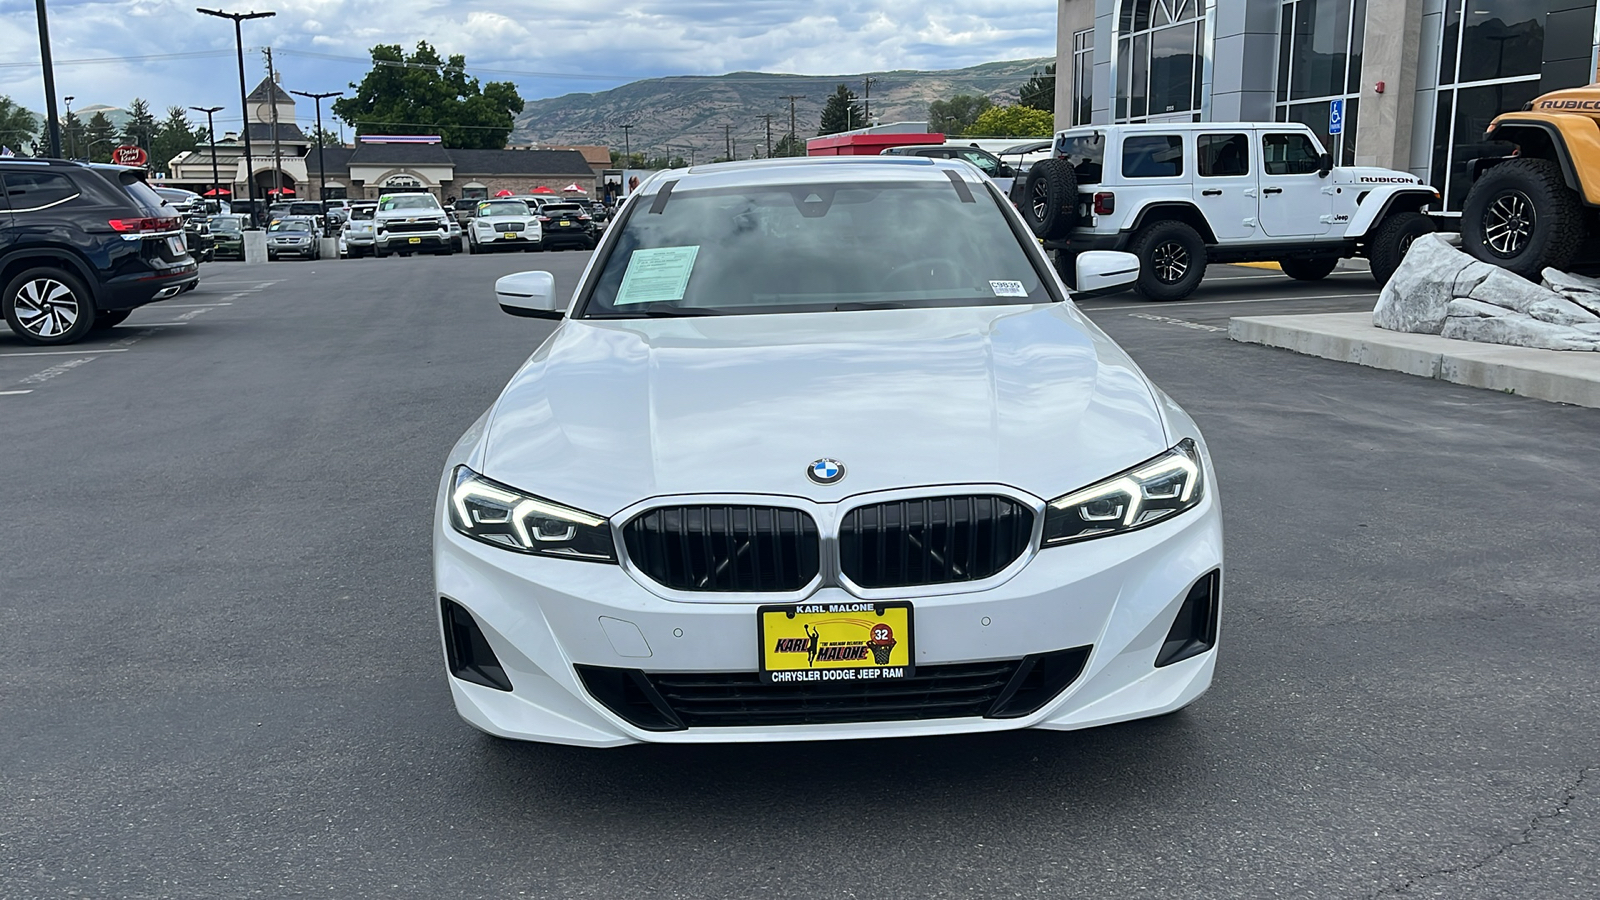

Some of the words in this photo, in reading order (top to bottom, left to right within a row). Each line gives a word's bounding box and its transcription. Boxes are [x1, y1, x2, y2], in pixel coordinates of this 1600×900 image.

[118, 148, 140, 160] Dairy
[796, 604, 826, 613] KARL
[829, 603, 874, 613] MALONE
[875, 629, 888, 640] 32
[774, 638, 810, 653] KARL
[816, 646, 869, 661] MALONE
[772, 671, 820, 682] CHRYSLER
[822, 669, 856, 680] DODGE
[857, 669, 881, 679] JEEP
[882, 668, 904, 678] RAM
